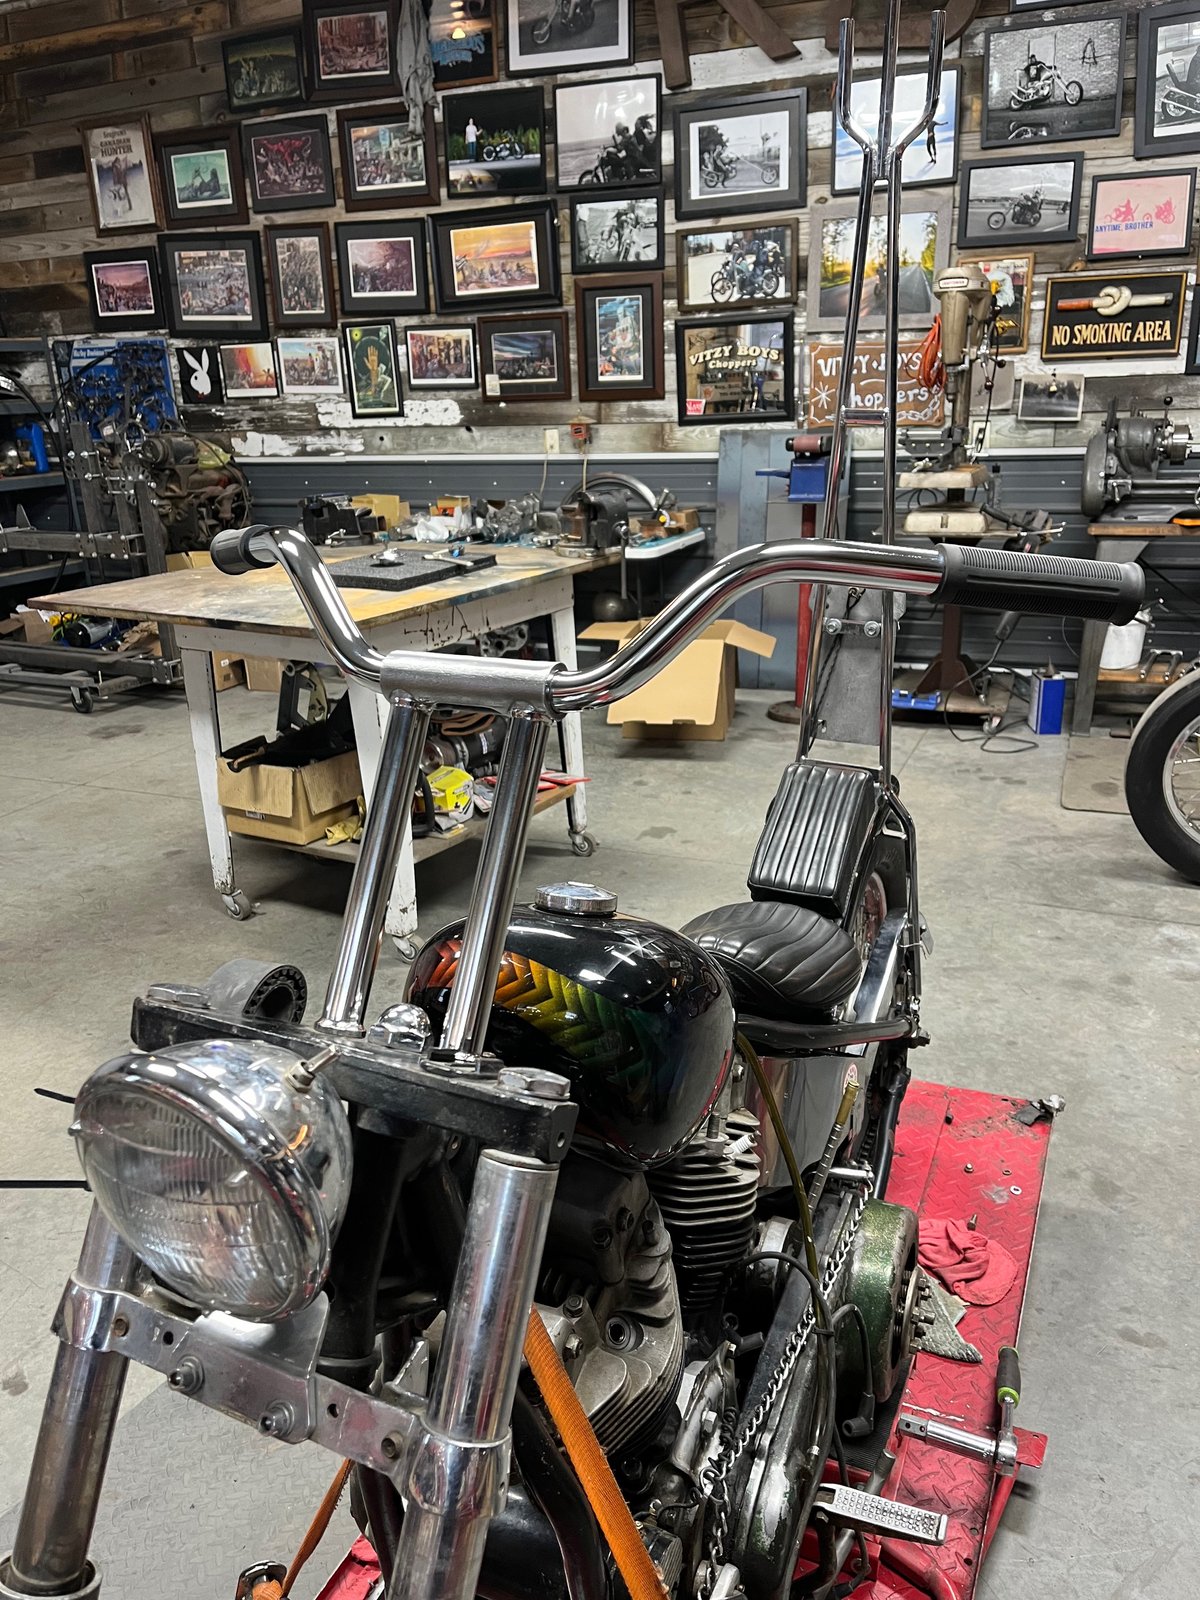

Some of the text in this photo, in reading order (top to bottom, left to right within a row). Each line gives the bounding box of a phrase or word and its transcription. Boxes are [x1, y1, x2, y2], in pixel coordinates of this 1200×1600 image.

[100, 138, 131, 147] CANADIAN
[101, 145, 133, 157] HUNTER
[1124, 220, 1154, 231] BROTHER
[1052, 320, 1172, 346] NO SMOKING AREA
[689, 345, 780, 366] VITZY BOYS
[708, 359, 757, 370] Choppers
[837, 382, 929, 410] hopers
